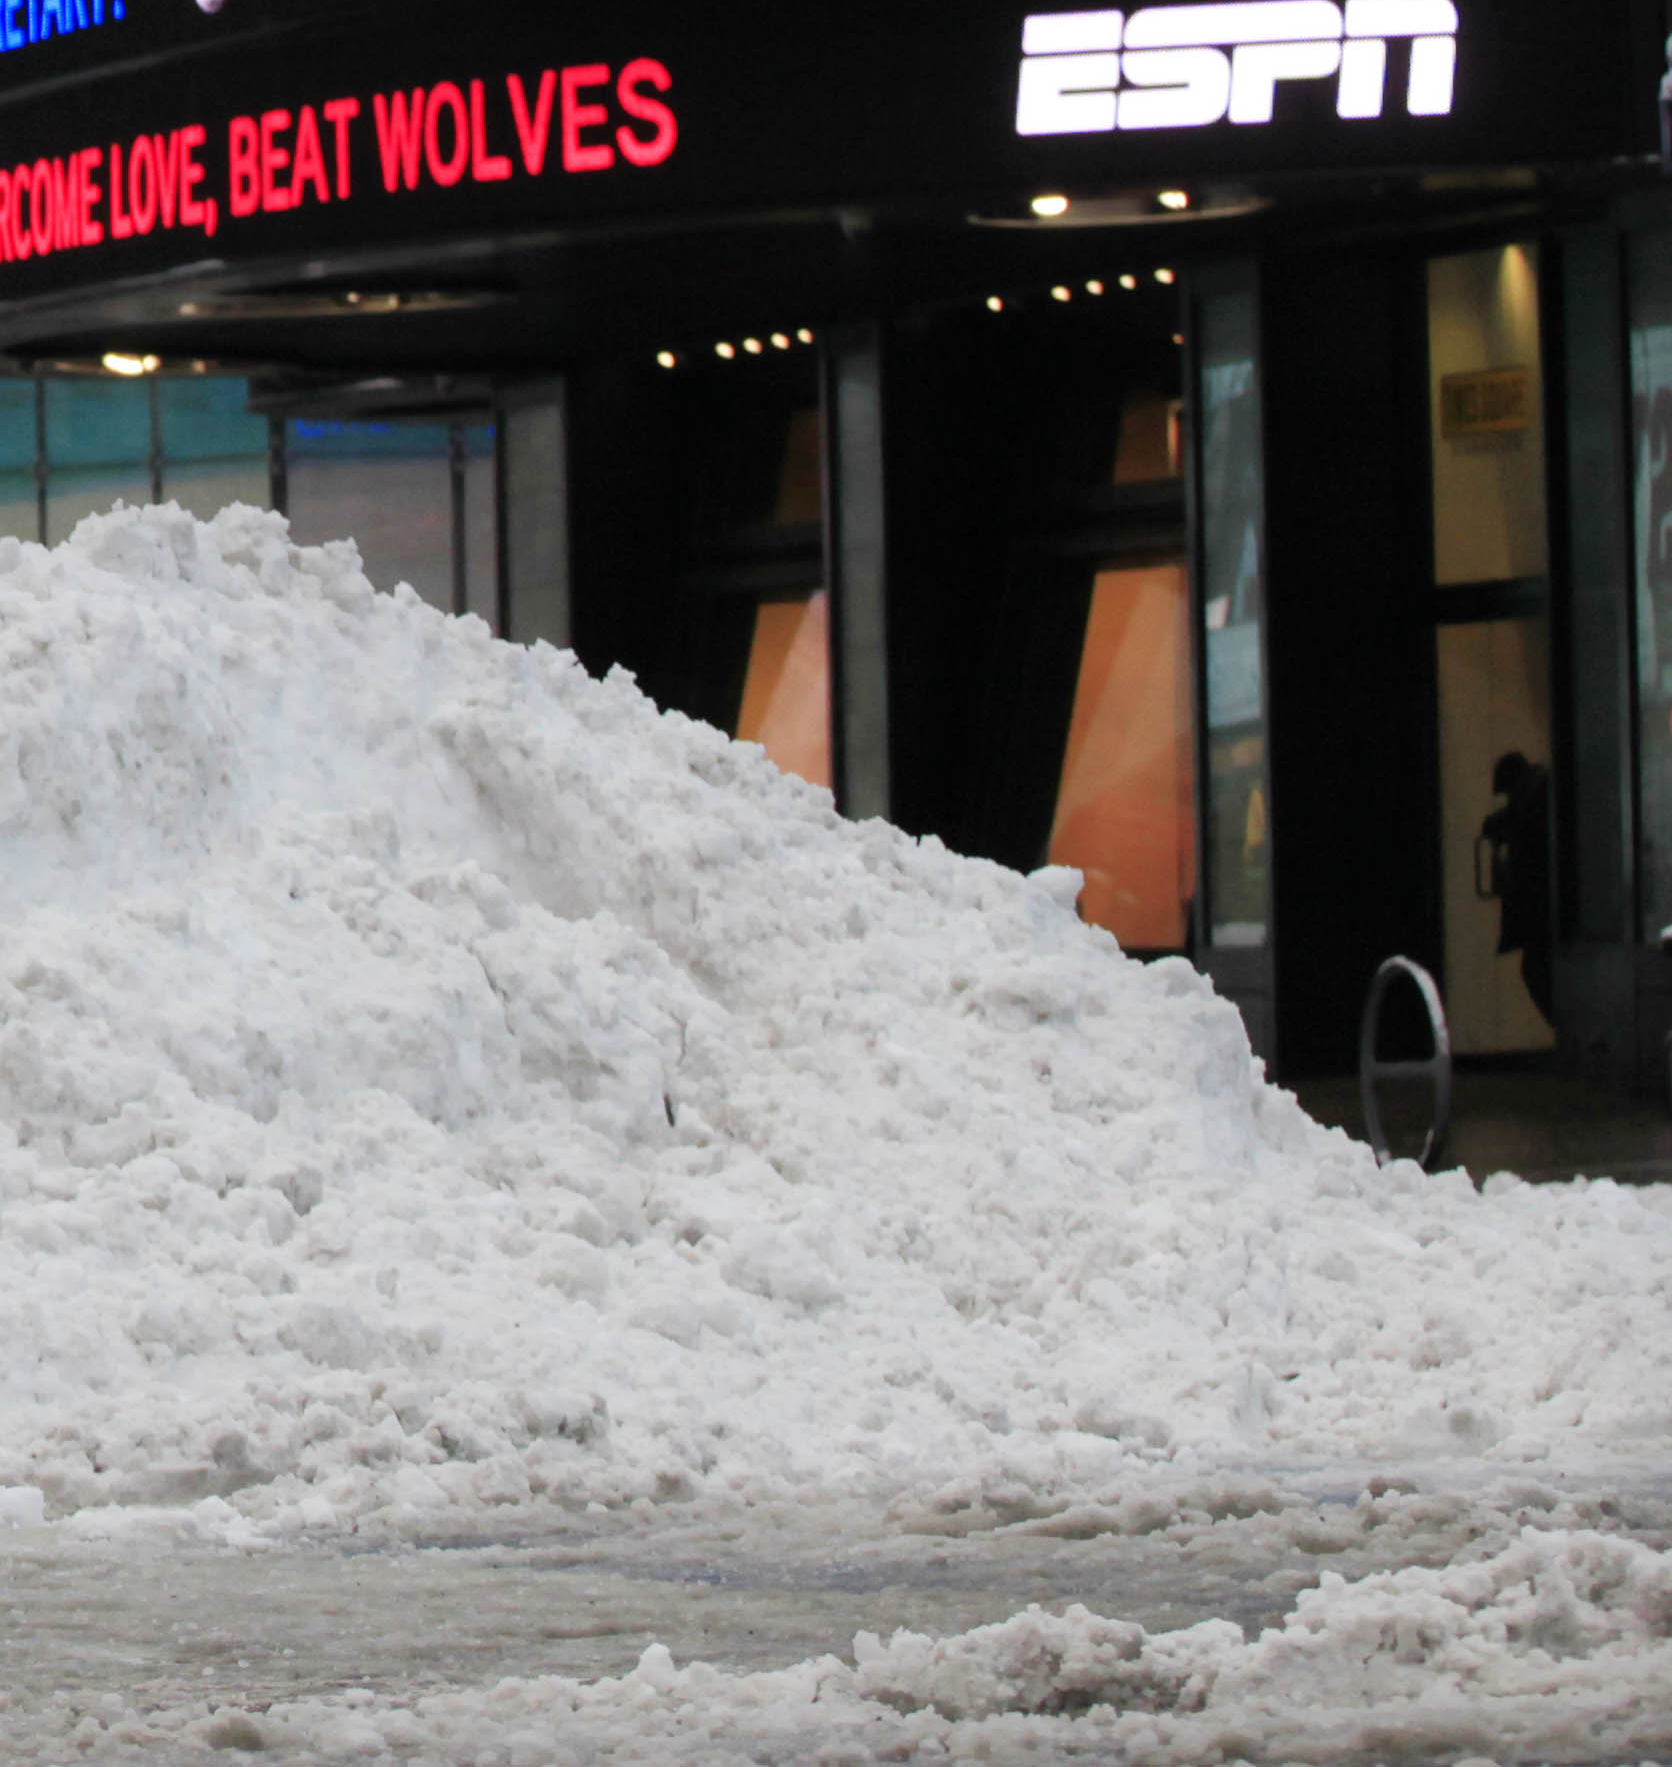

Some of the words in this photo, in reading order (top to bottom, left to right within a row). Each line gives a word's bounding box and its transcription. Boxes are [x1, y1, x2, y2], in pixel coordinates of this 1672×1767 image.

[109, 124, 218, 237] LOVE,
[227, 96, 361, 218] BEAT
[373, 56, 678, 195] WOLVES
